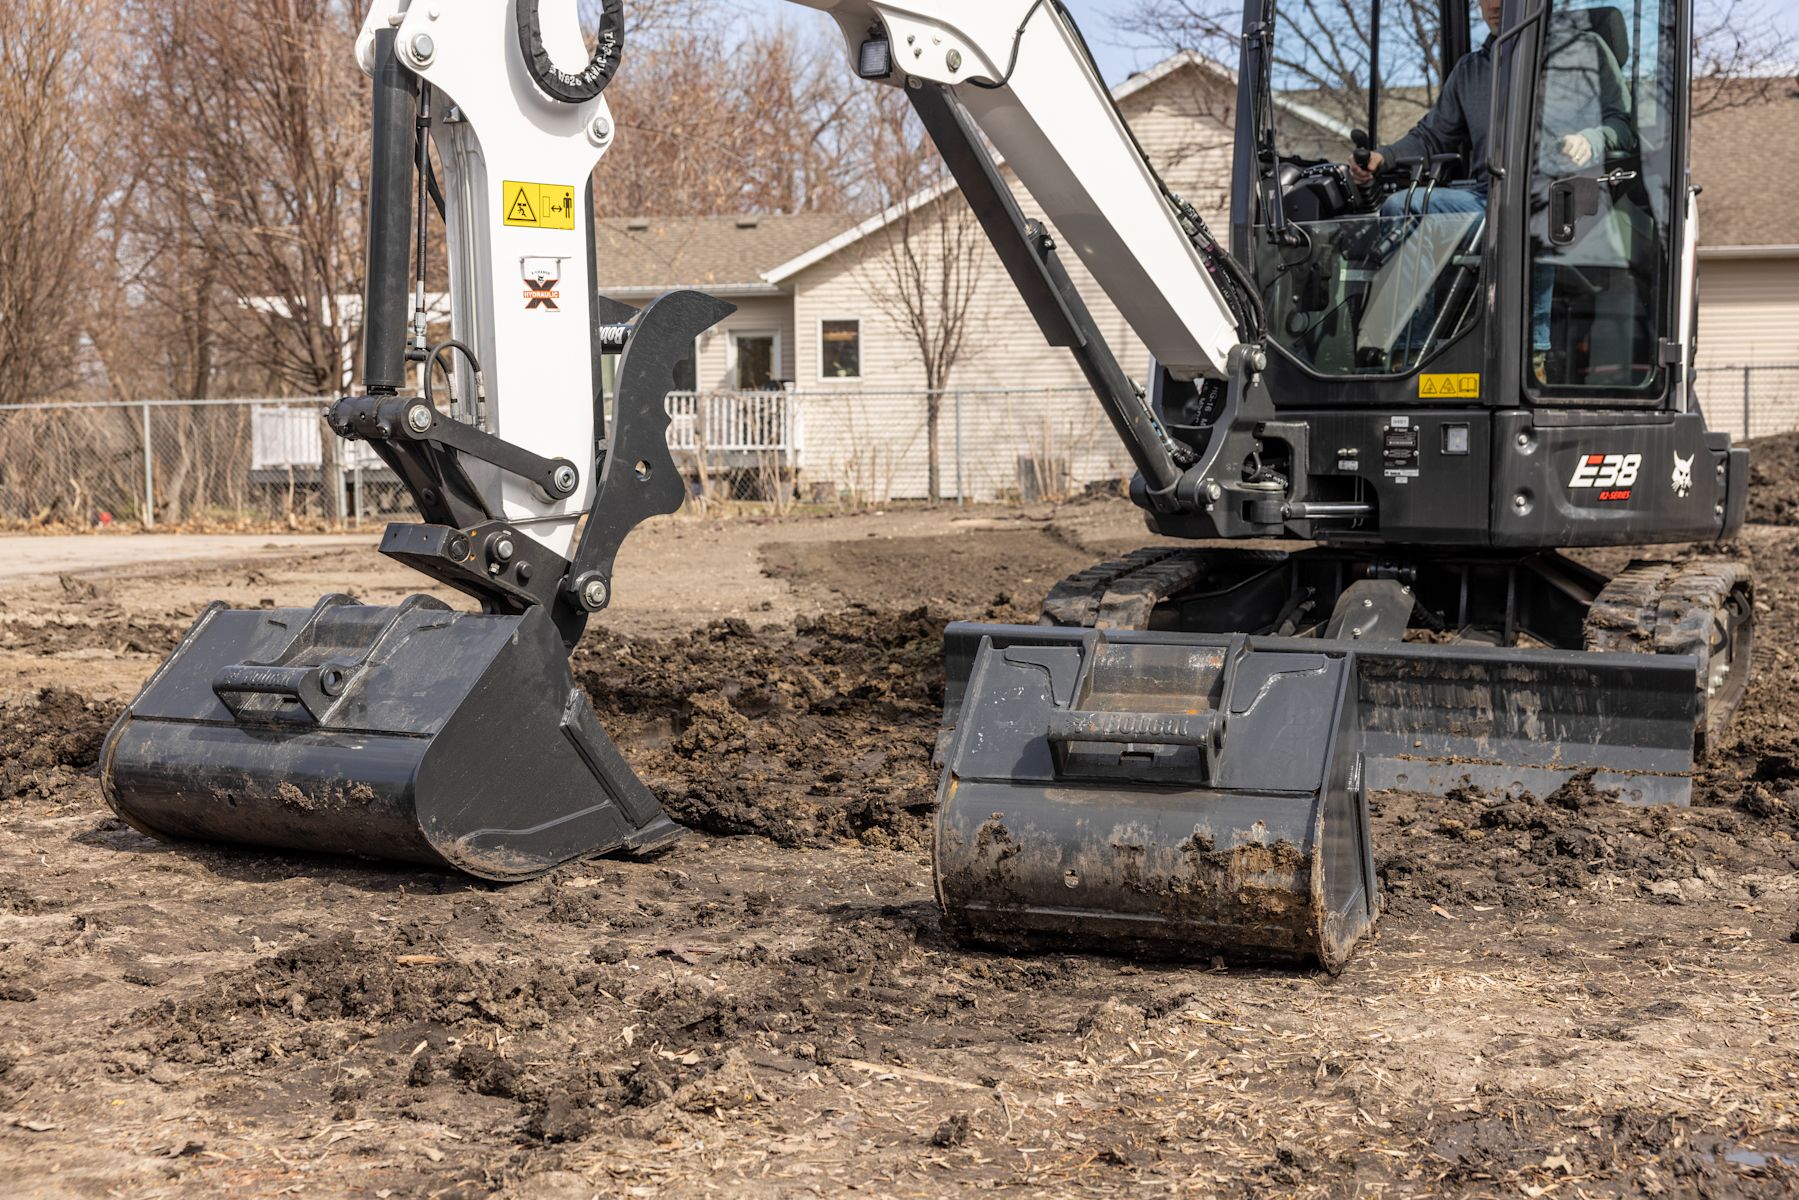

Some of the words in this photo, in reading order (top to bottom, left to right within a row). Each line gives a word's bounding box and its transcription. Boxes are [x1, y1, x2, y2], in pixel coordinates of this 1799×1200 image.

[1568, 453, 1642, 488] E38
[1599, 490, 1631, 500] R2-SERIES
[1103, 713, 1189, 737] Bobcat
